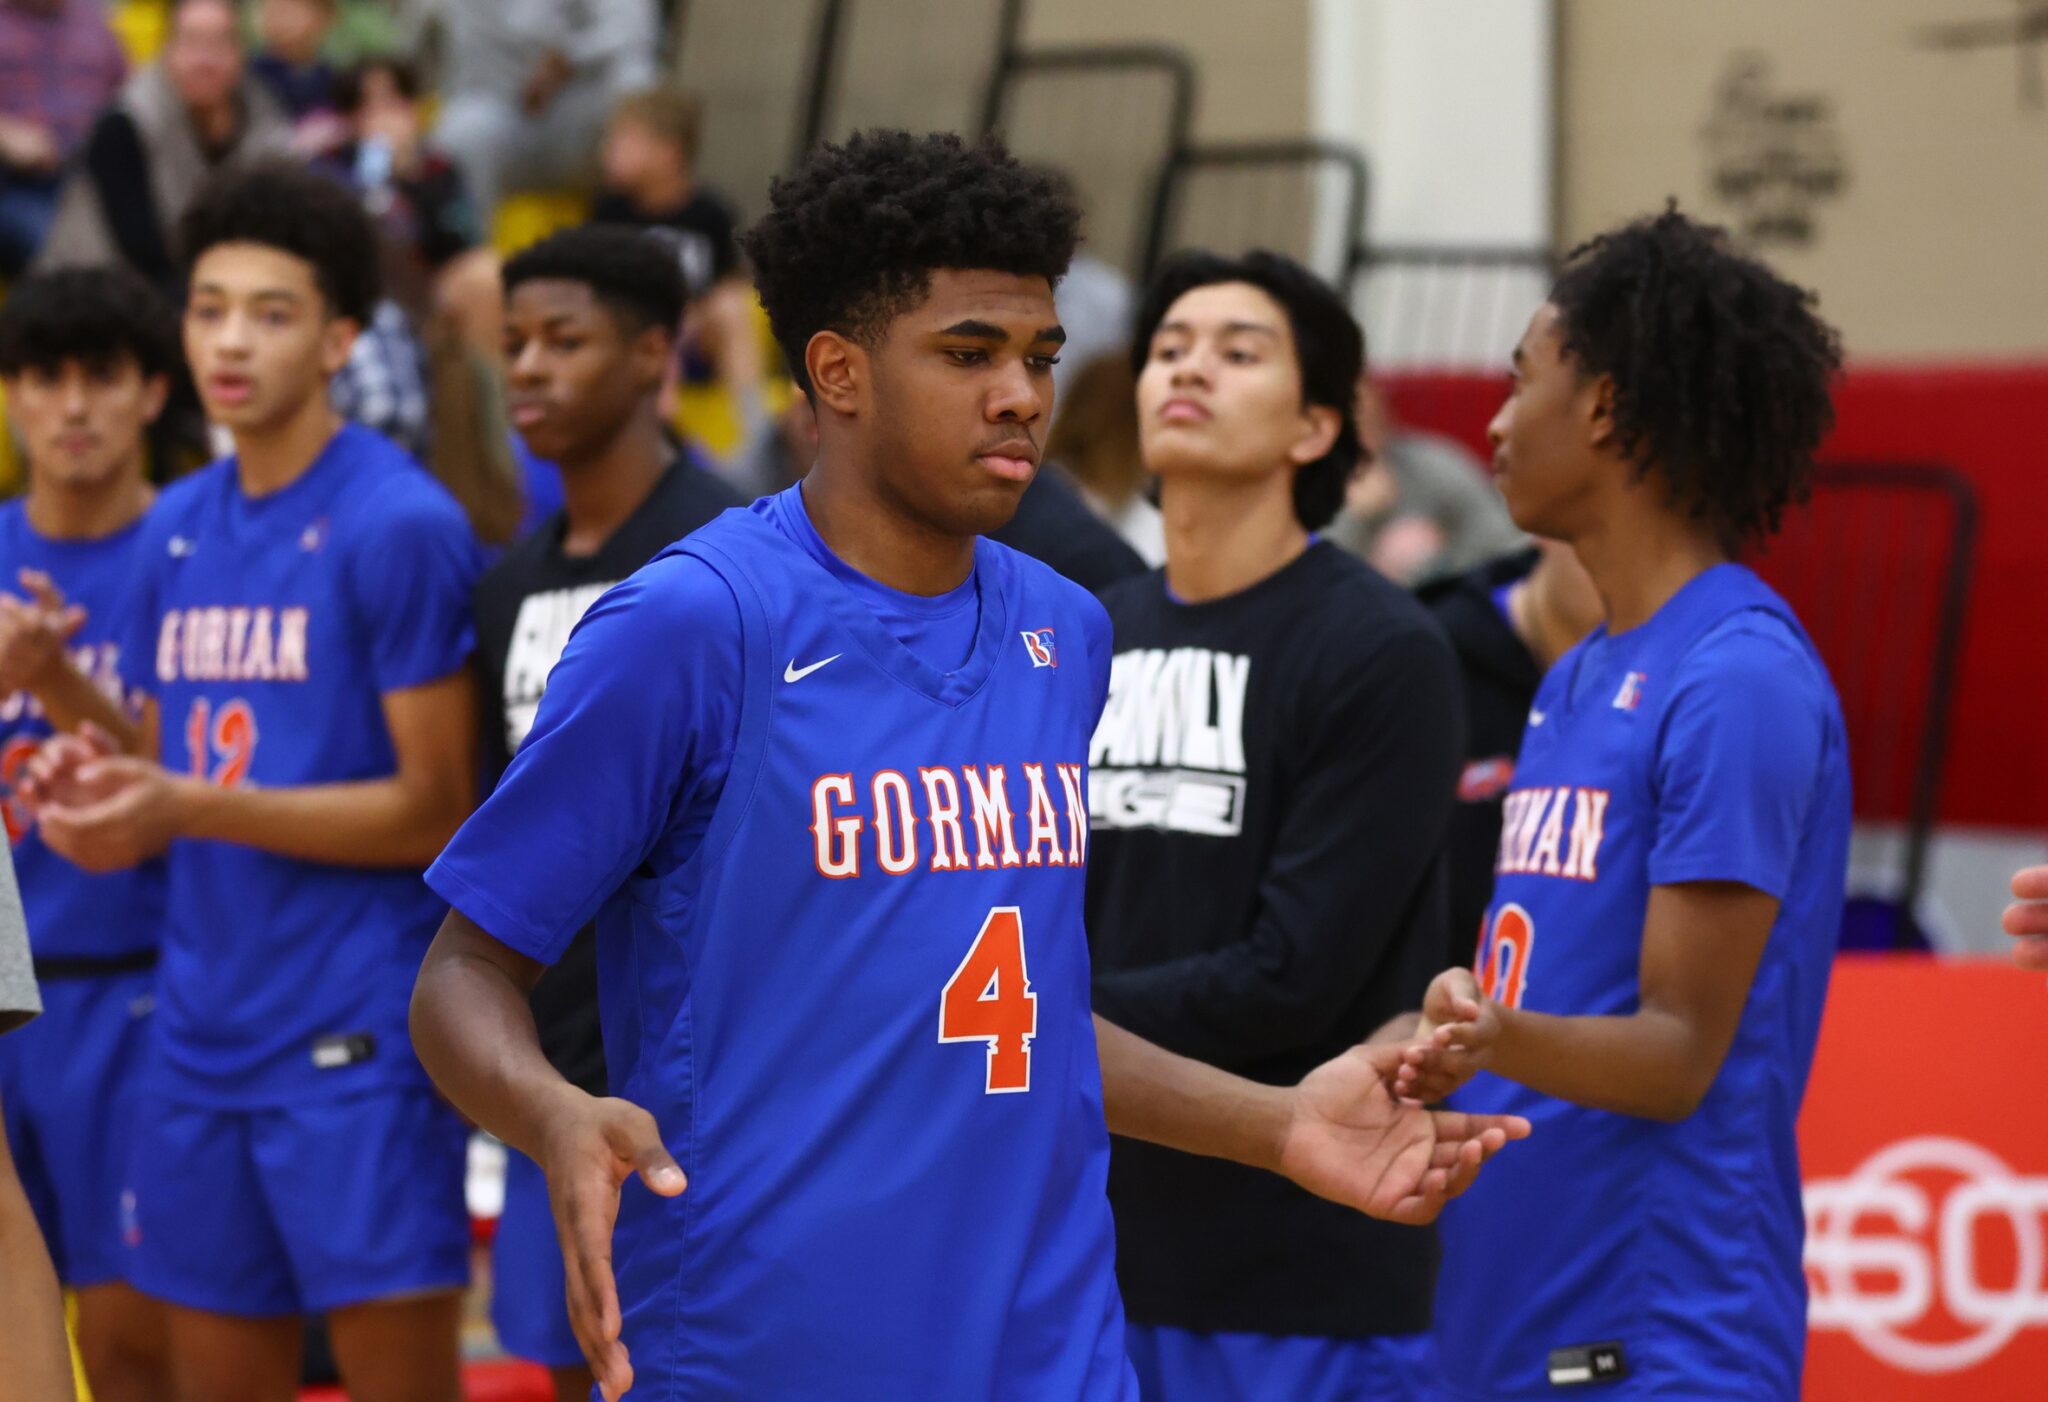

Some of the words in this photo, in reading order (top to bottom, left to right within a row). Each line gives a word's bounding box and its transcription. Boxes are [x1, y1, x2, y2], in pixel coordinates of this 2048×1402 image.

[1088, 647, 1251, 774] AMILY
[809, 762, 1087, 879] GORMAN
[938, 905, 1037, 1094] 4
